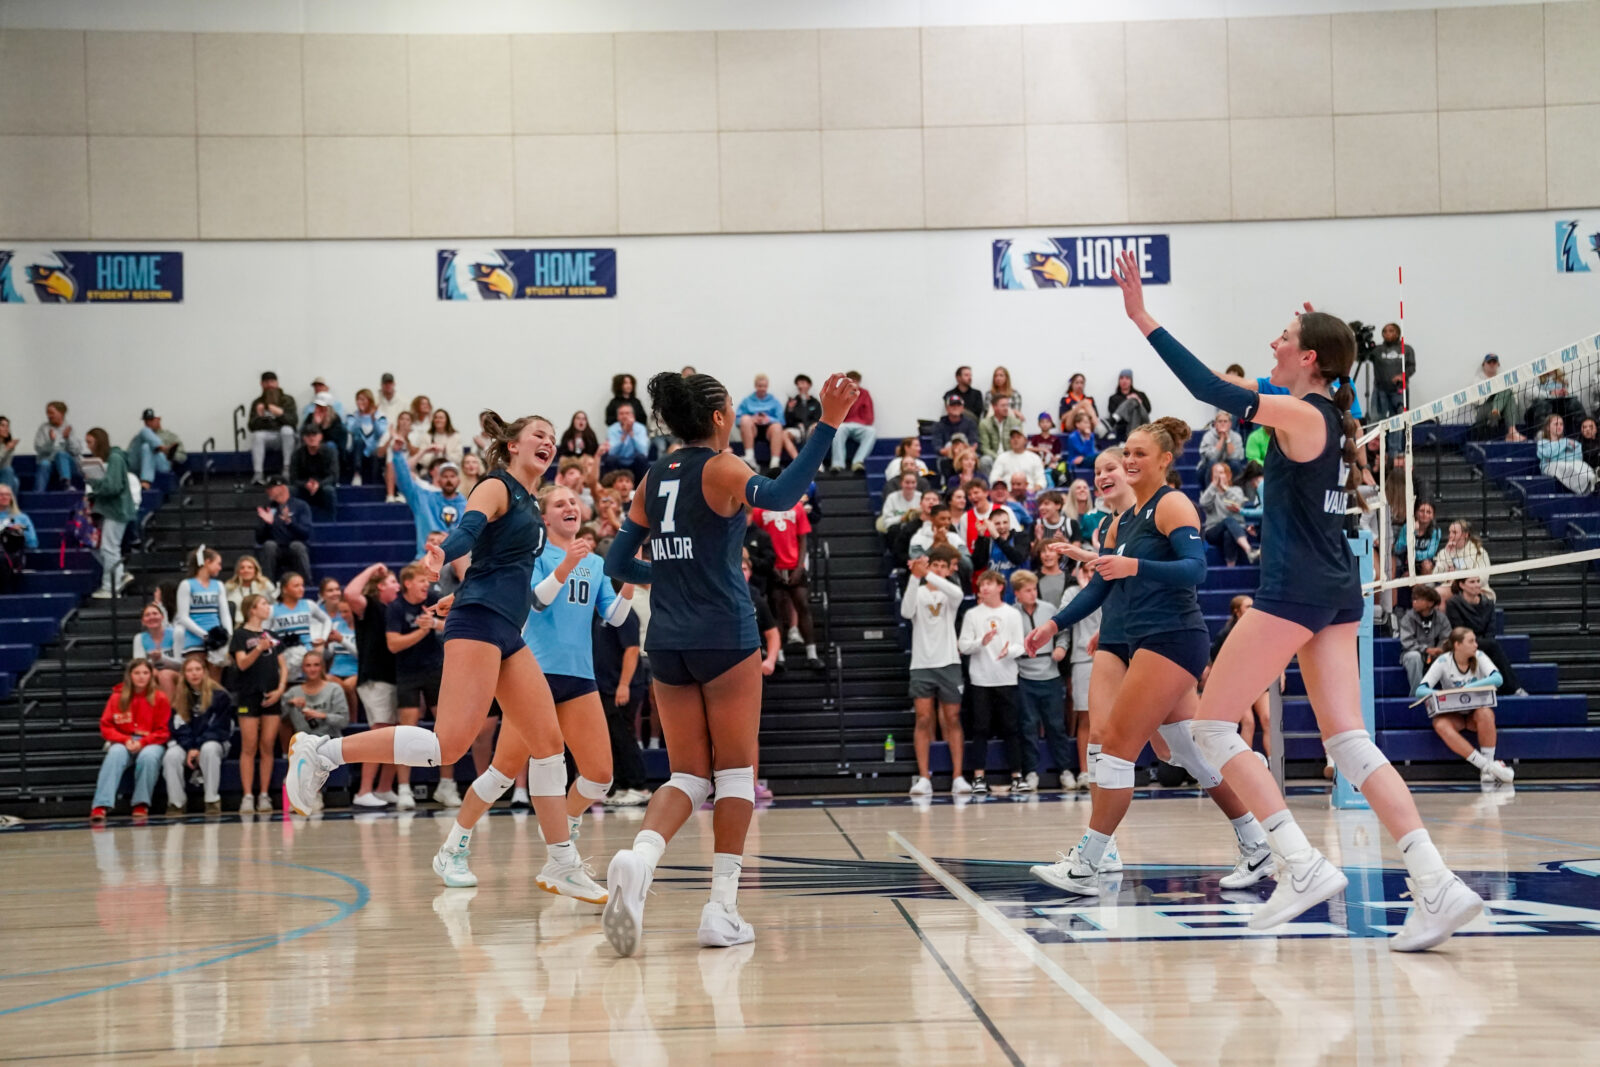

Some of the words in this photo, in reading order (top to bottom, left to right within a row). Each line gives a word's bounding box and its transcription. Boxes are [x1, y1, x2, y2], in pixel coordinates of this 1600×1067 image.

[534, 252, 596, 286] HOME
[1076, 237, 1153, 280] HOME
[96, 255, 162, 290] HOME
[86, 291, 130, 300] STUDENT
[132, 290, 173, 299] SECTION
[525, 287, 567, 296] STUDENT
[568, 286, 607, 295] SECTION
[658, 479, 680, 533] 7
[651, 536, 694, 560] VALOR
[570, 567, 591, 577] ALOR
[567, 578, 590, 605] 10
[277, 613, 310, 628] VALOR
